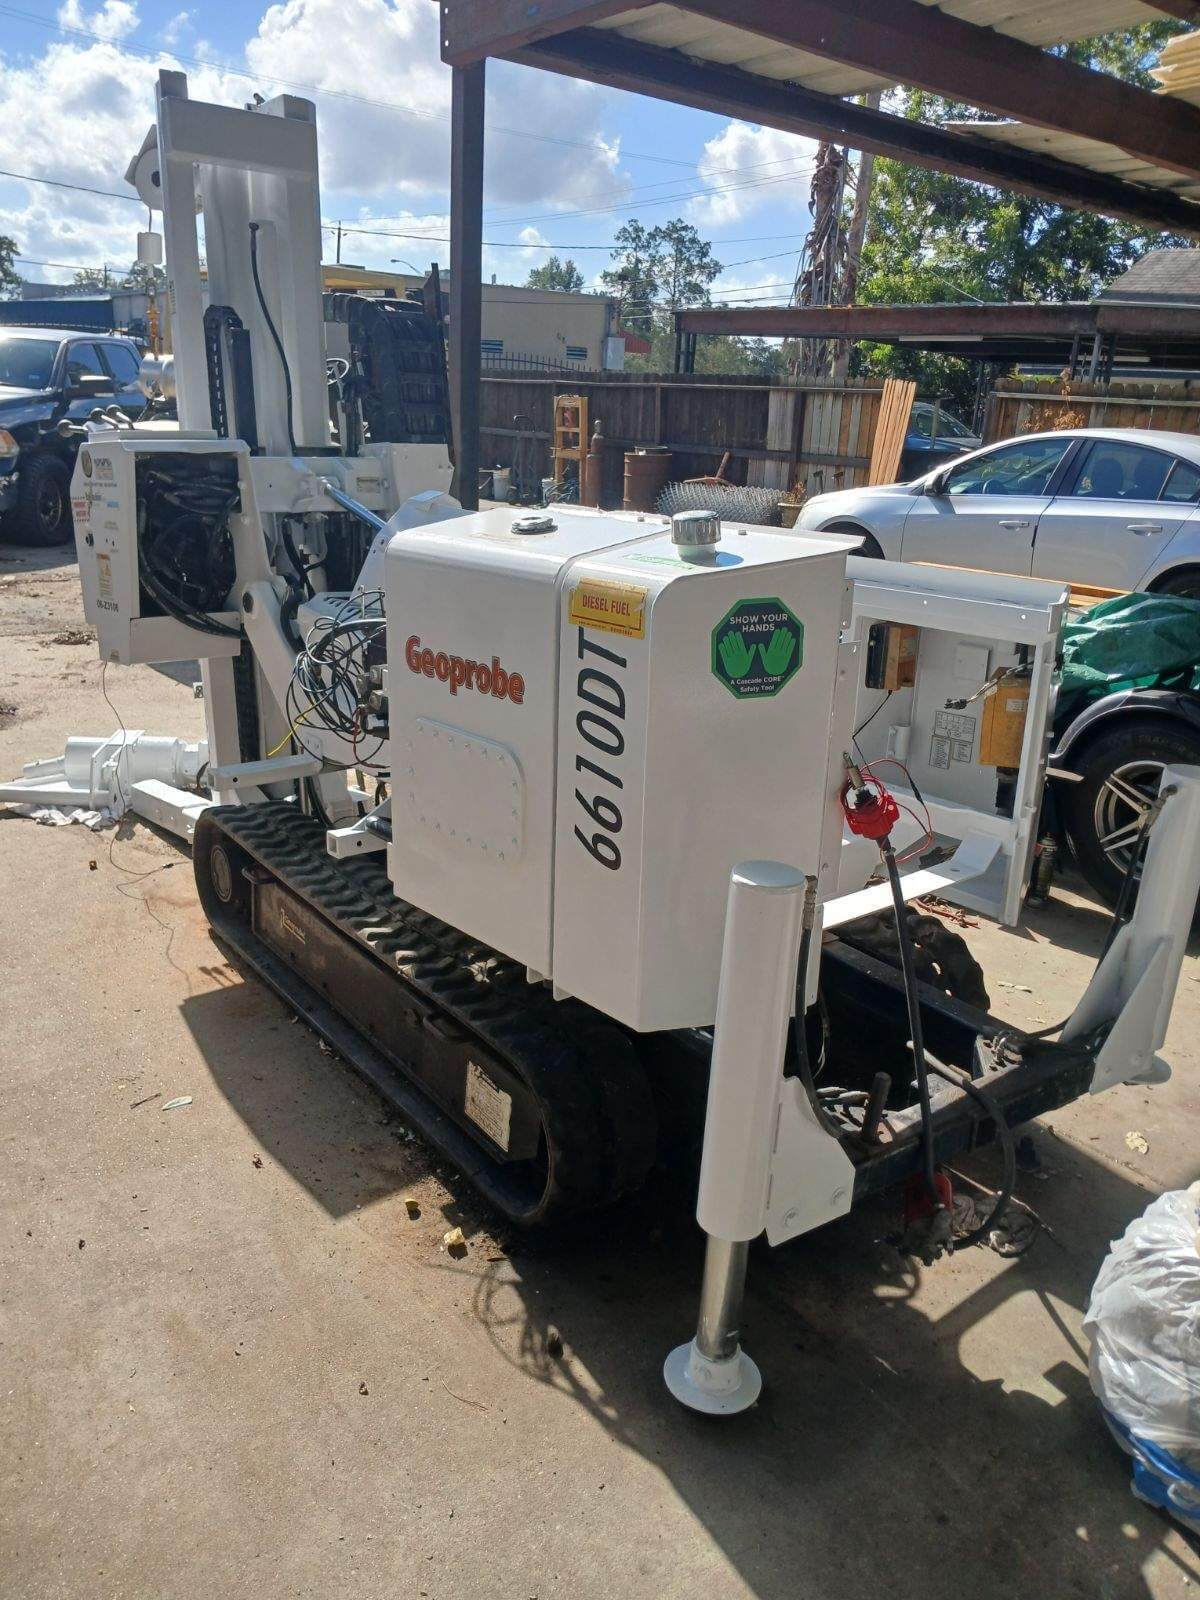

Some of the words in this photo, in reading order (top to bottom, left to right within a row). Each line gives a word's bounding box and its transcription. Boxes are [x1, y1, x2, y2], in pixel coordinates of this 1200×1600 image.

[582, 594, 609, 612] DIESEL
[610, 600, 631, 616] FUEL
[729, 615, 759, 625] SHOW
[762, 613, 788, 622] YOUR
[742, 623, 775, 633] HANDS
[405, 635, 525, 705] Geoprobe
[736, 677, 762, 685] Cascade
[574, 626, 627, 871] 6610DT
